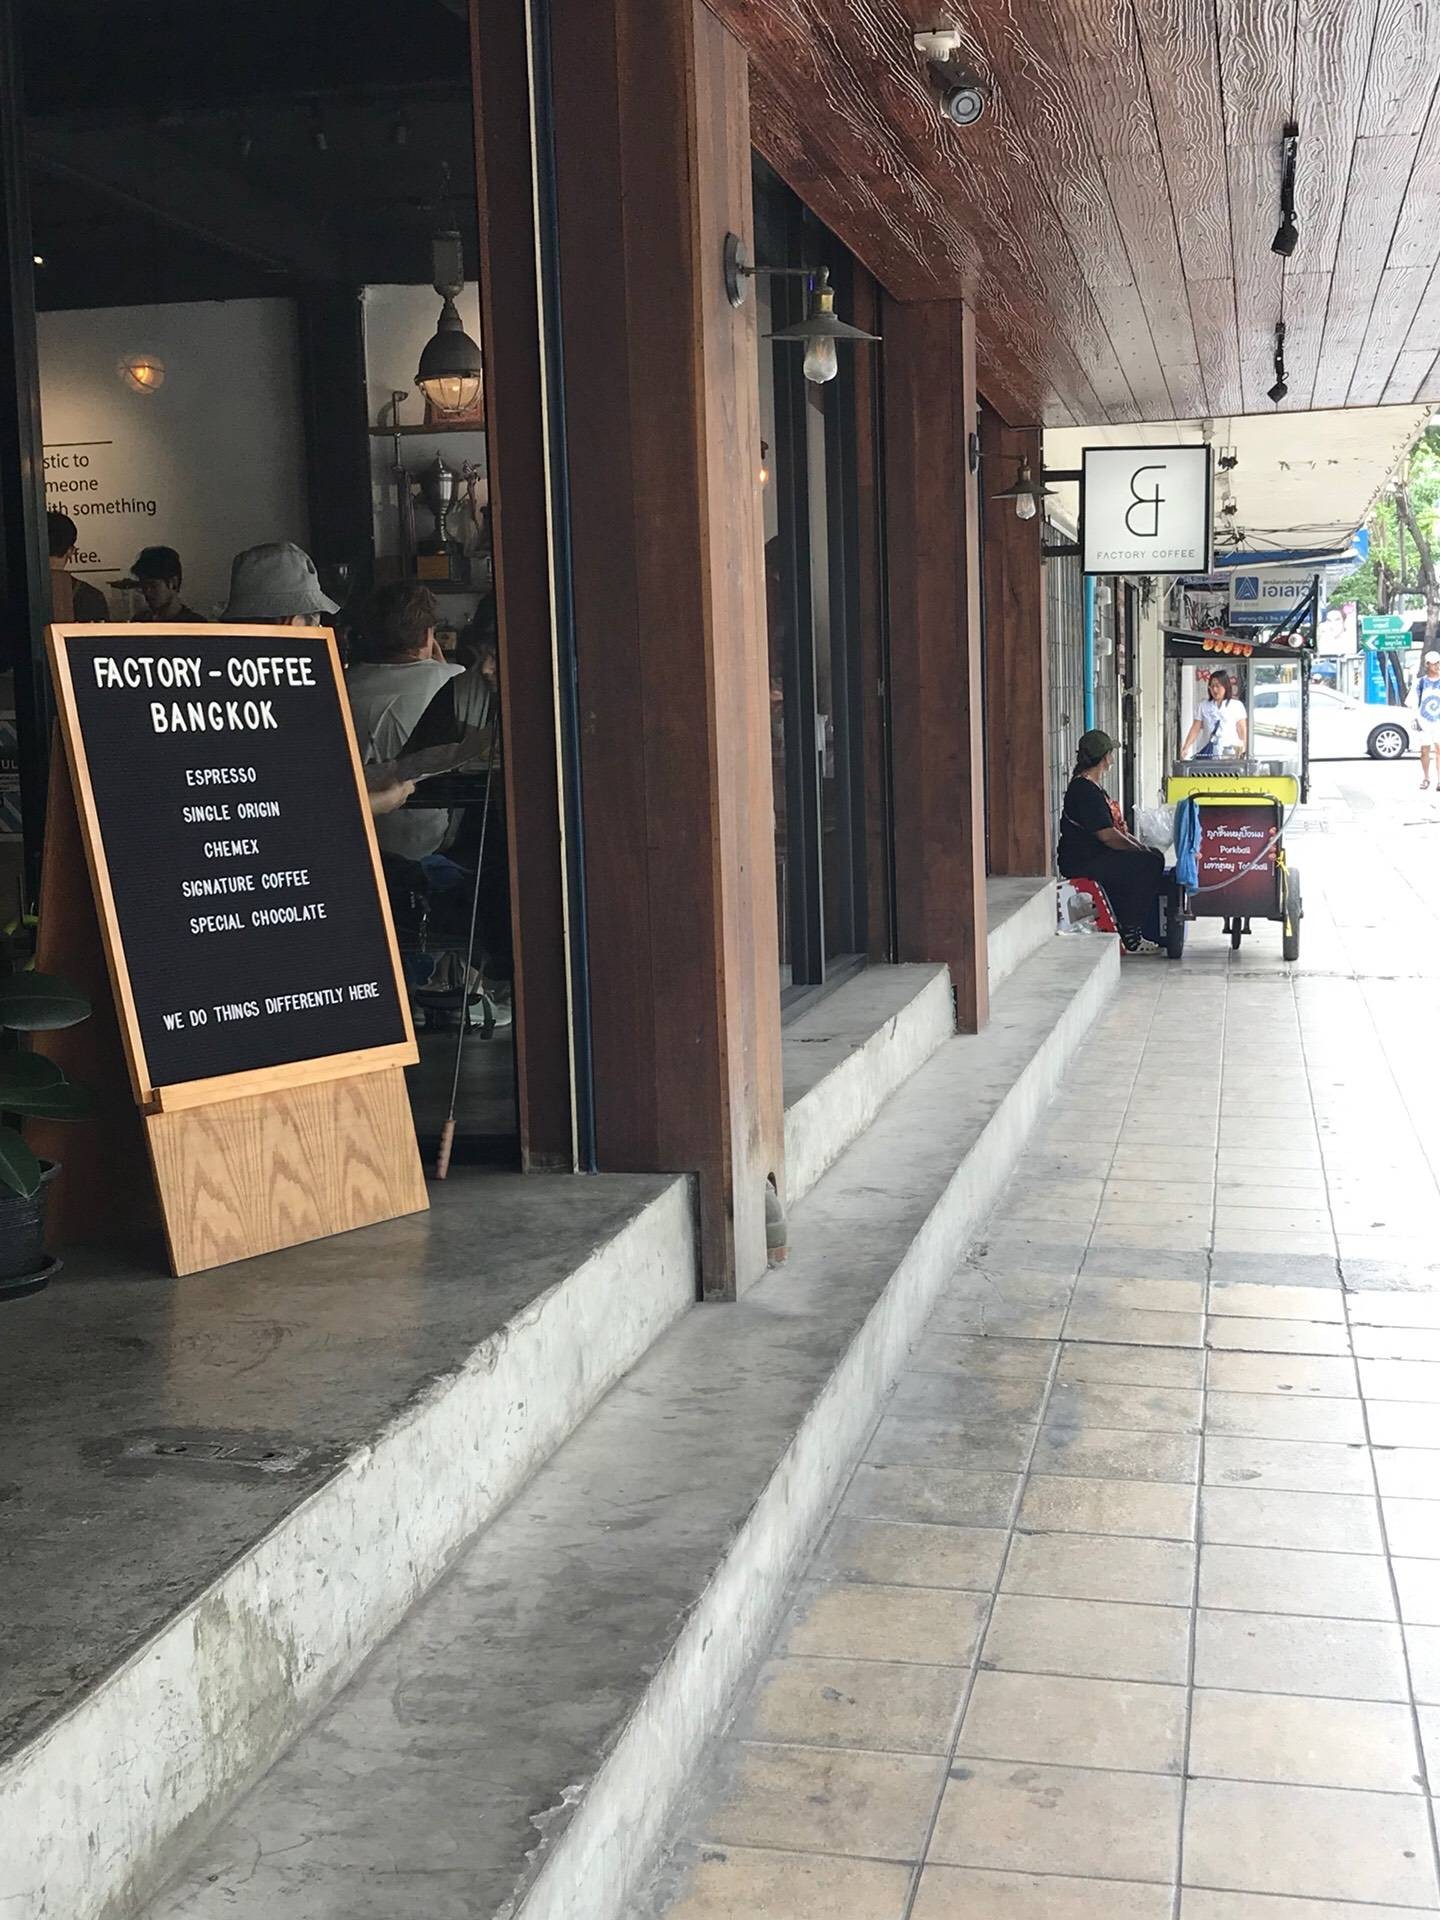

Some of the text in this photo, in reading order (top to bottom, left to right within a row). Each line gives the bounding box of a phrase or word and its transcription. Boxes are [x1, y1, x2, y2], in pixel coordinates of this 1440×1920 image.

[72, 453, 89, 468] to
[73, 498, 157, 517] something
[1096, 549, 1196, 560] FACTORY COFFEE
[94, 657, 202, 688] FACTORY
[228, 656, 317, 688] COFFEE
[150, 700, 278, 733] BANGKOK
[185, 766, 257, 787] ESPRESSO
[182, 800, 281, 823] SINGLE ORIGIN
[203, 838, 260, 859] CHEMEX
[181, 869, 311, 898] SIGNATURE COFFEE
[189, 902, 328, 935] SPECIAL CHOCOLATE
[162, 981, 380, 1031] WE DO THINGS DIFFERENTLY HERE
